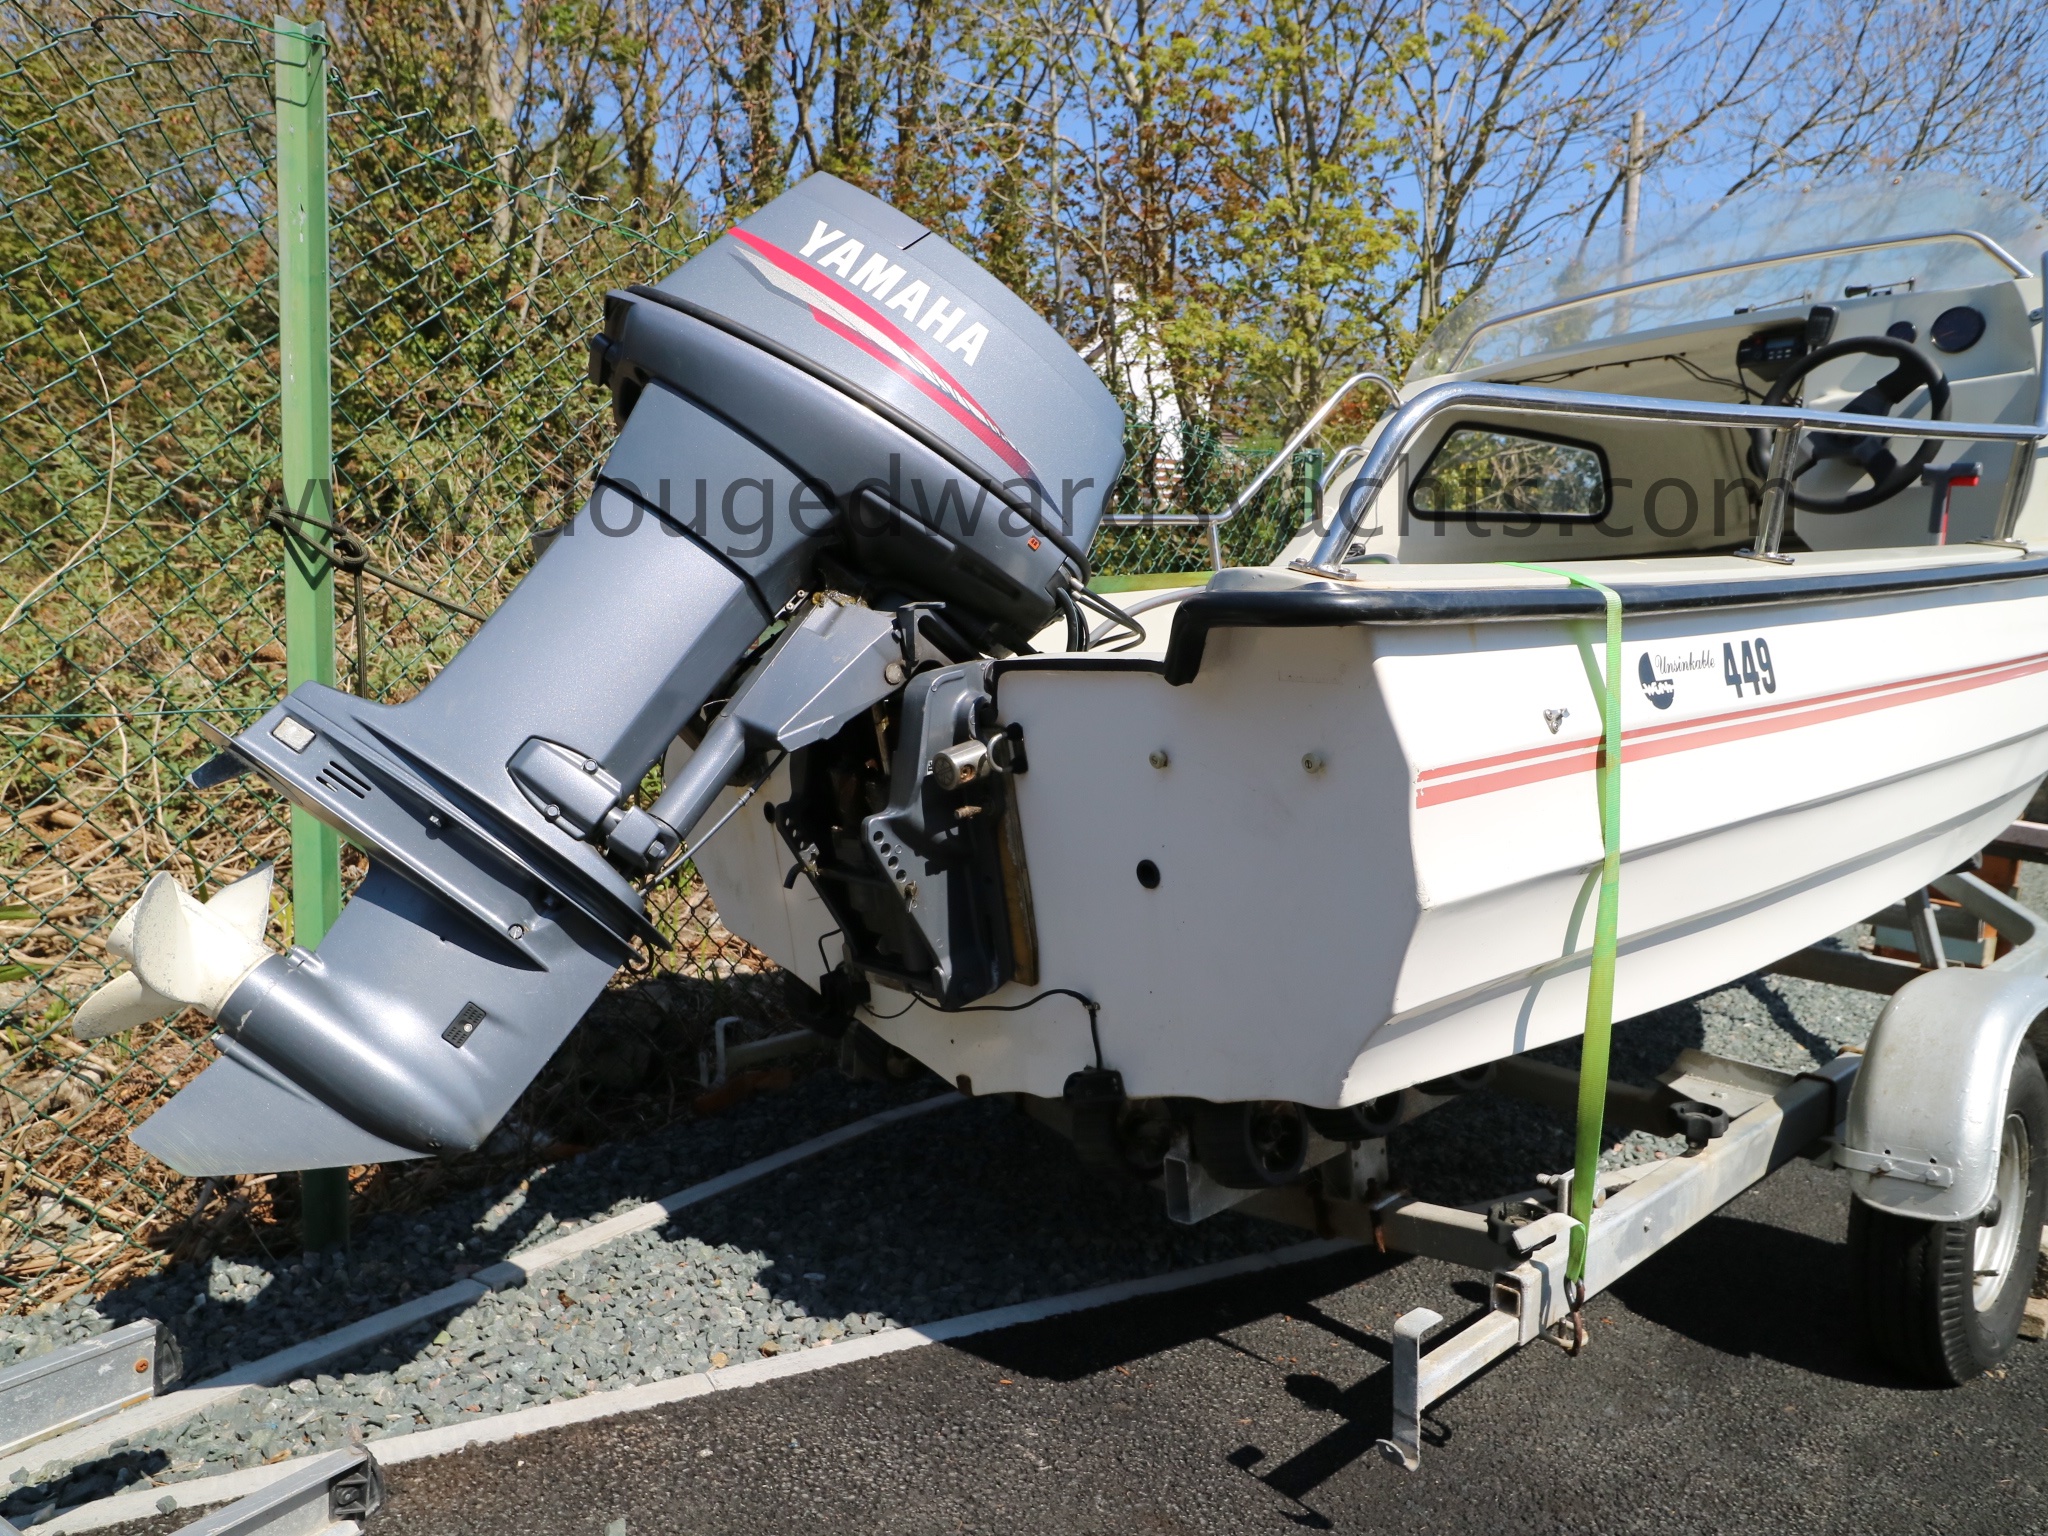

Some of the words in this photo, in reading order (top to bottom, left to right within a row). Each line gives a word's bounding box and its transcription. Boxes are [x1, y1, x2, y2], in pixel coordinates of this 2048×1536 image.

[799, 220, 989, 367] YAMAHA
[1655, 649, 1715, 674] Unsinkable
[1723, 637, 1777, 698] 449
